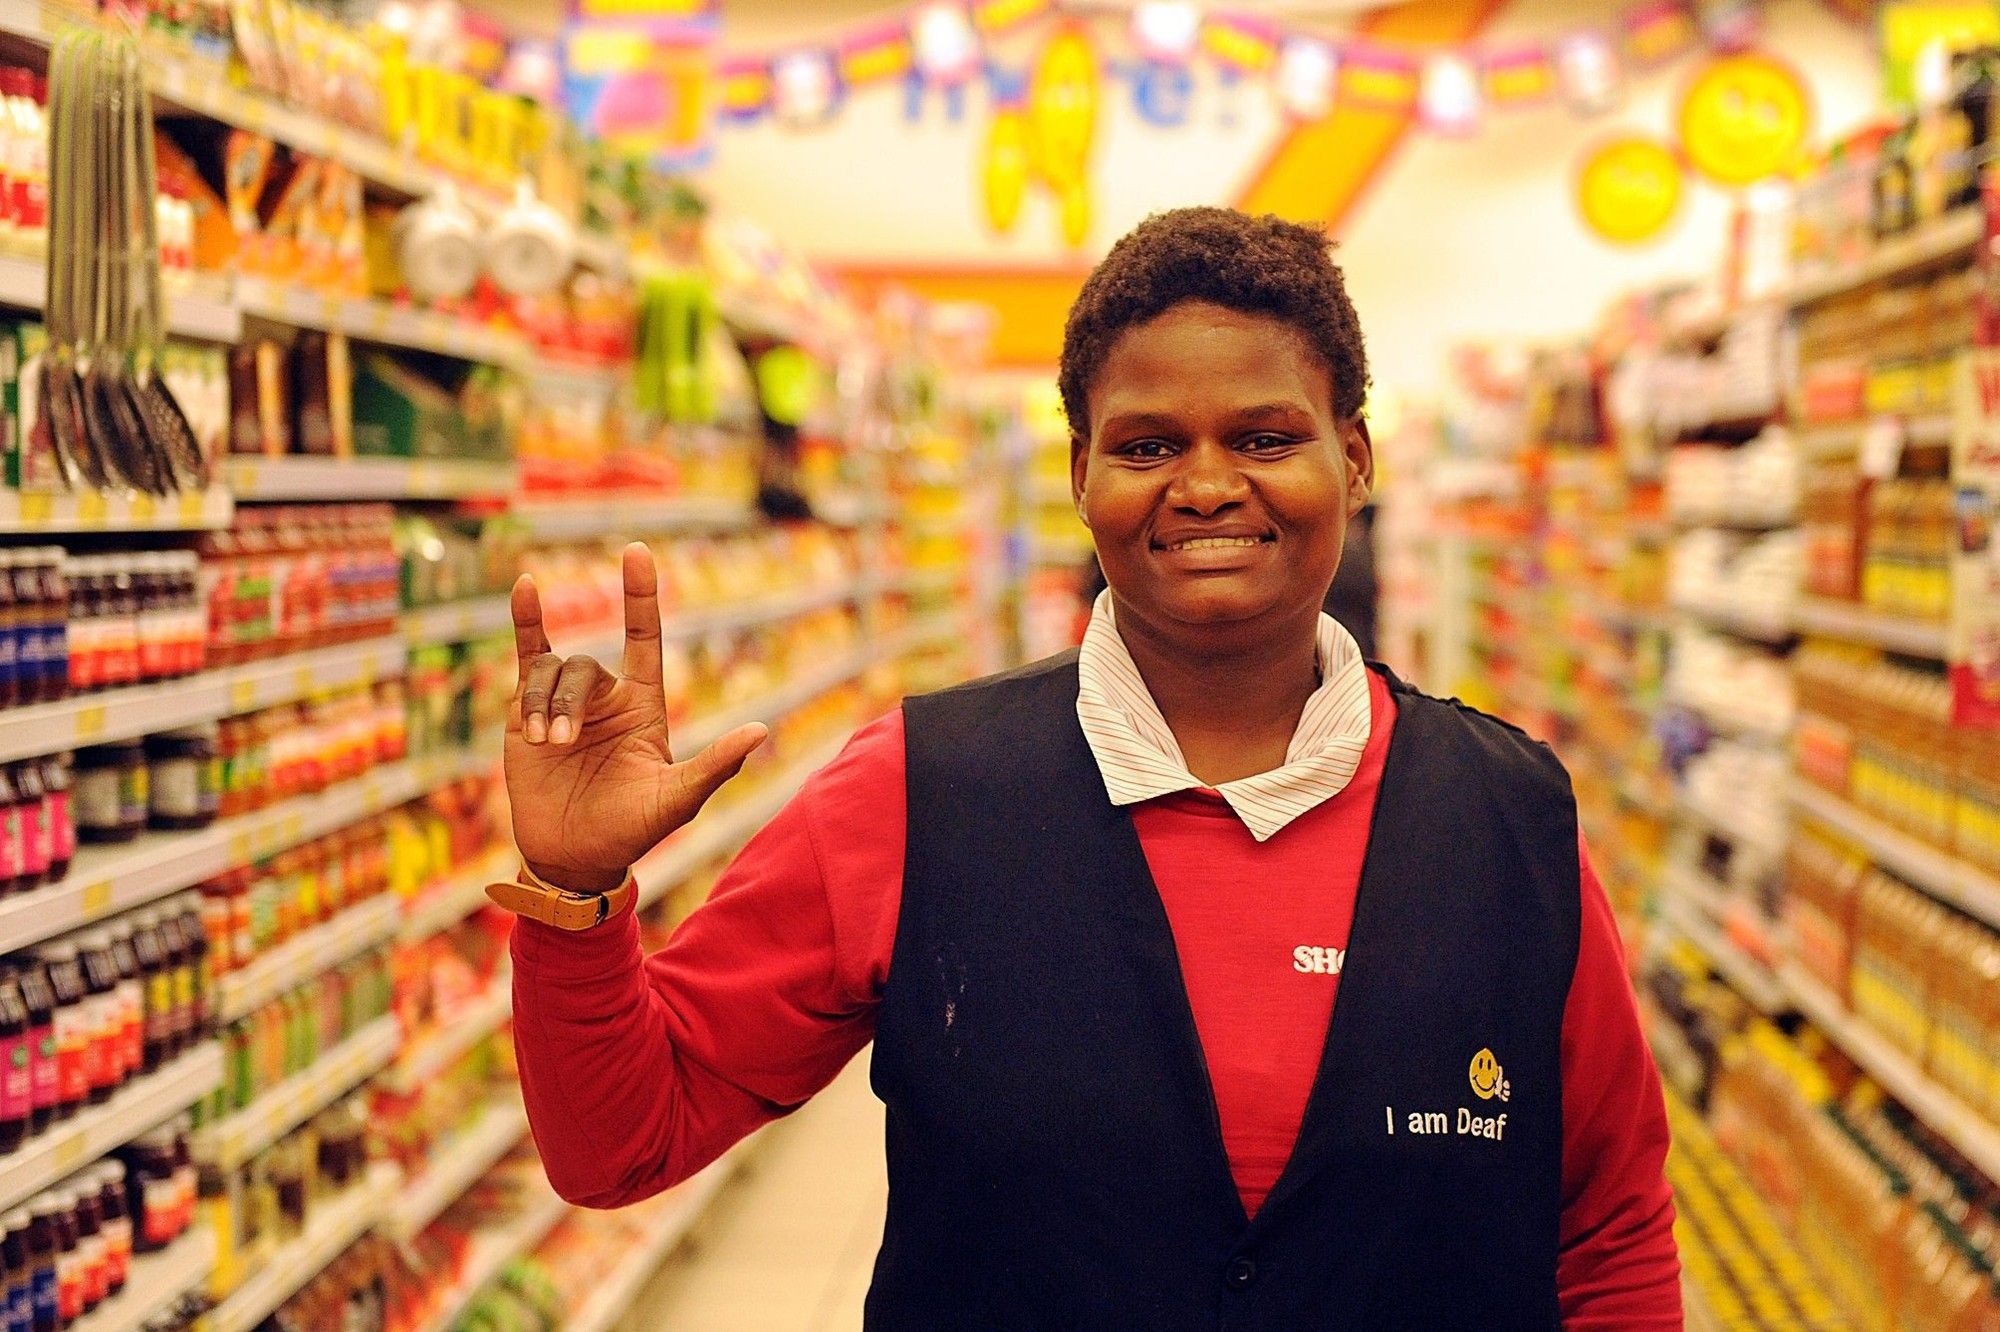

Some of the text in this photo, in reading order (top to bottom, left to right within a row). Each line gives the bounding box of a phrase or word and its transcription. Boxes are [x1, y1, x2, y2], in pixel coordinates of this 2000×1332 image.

[1386, 1106, 1508, 1140] I am Deaf
